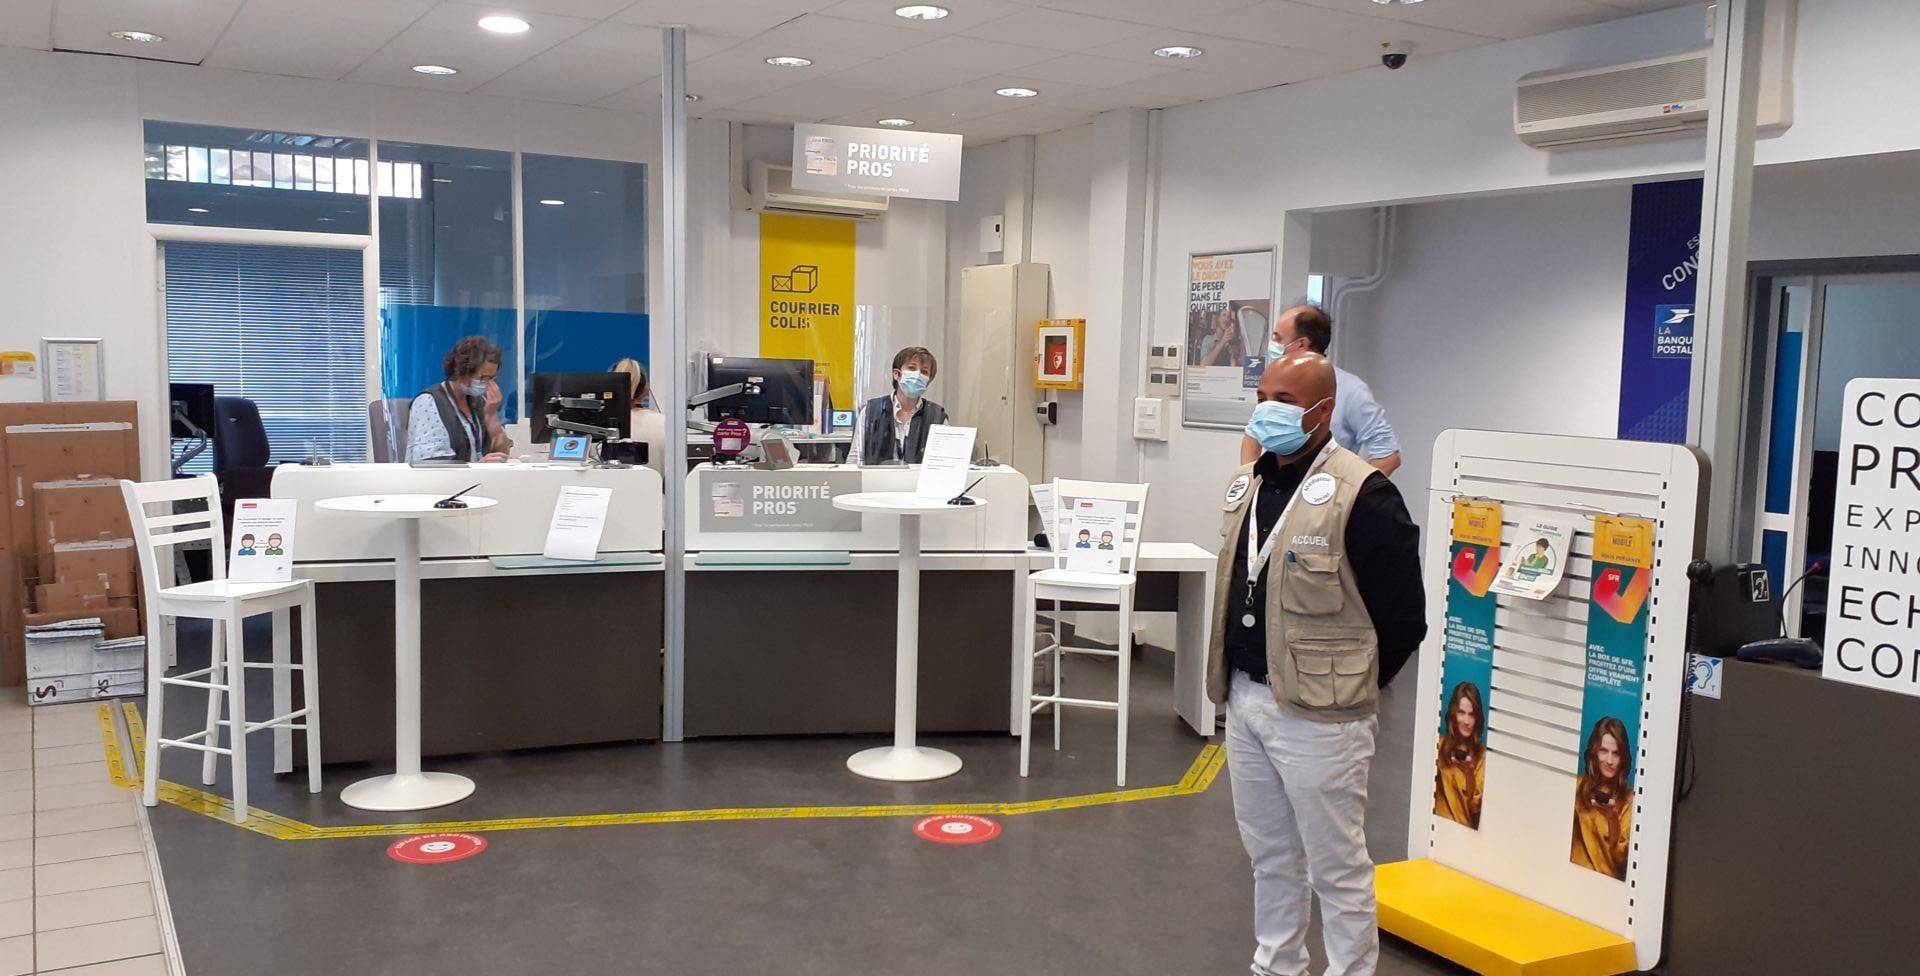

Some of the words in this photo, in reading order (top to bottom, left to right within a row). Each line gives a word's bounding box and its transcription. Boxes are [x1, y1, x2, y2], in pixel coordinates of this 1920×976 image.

[847, 143, 930, 164] PRIORITÉ
[1686, 233, 1700, 250] ES
[1191, 282, 1201, 292] DE
[1202, 281, 1225, 291] PESER
[1191, 292, 1211, 302] DANS
[1212, 292, 1222, 301] LE
[770, 301, 840, 315] COURRIER
[1190, 302, 1228, 313] QUARTIER
[770, 316, 810, 329] COLIS
[1658, 327, 1671, 335] LA
[752, 481, 830, 499] PRIORITÉ
[1291, 535, 1329, 546] ACCUEIL
[1612, 538, 1631, 548] MOBILE
[1844, 544, 1920, 576] INN
[1607, 573, 1620, 582] SFR
[1589, 644, 1605, 653] AVEC
[1597, 653, 1610, 662] BOX
[1611, 655, 1620, 664] DE
[1836, 637, 1920, 683] CO
[1588, 658, 1616, 671] PROFITEZ
[1618, 664, 1636, 675] D'UNE
[1588, 666, 1607, 677] OFFRE
[1608, 670, 1640, 683] VRAIMENT
[36, 685, 56, 699] S
[98, 679, 109, 694] XS
